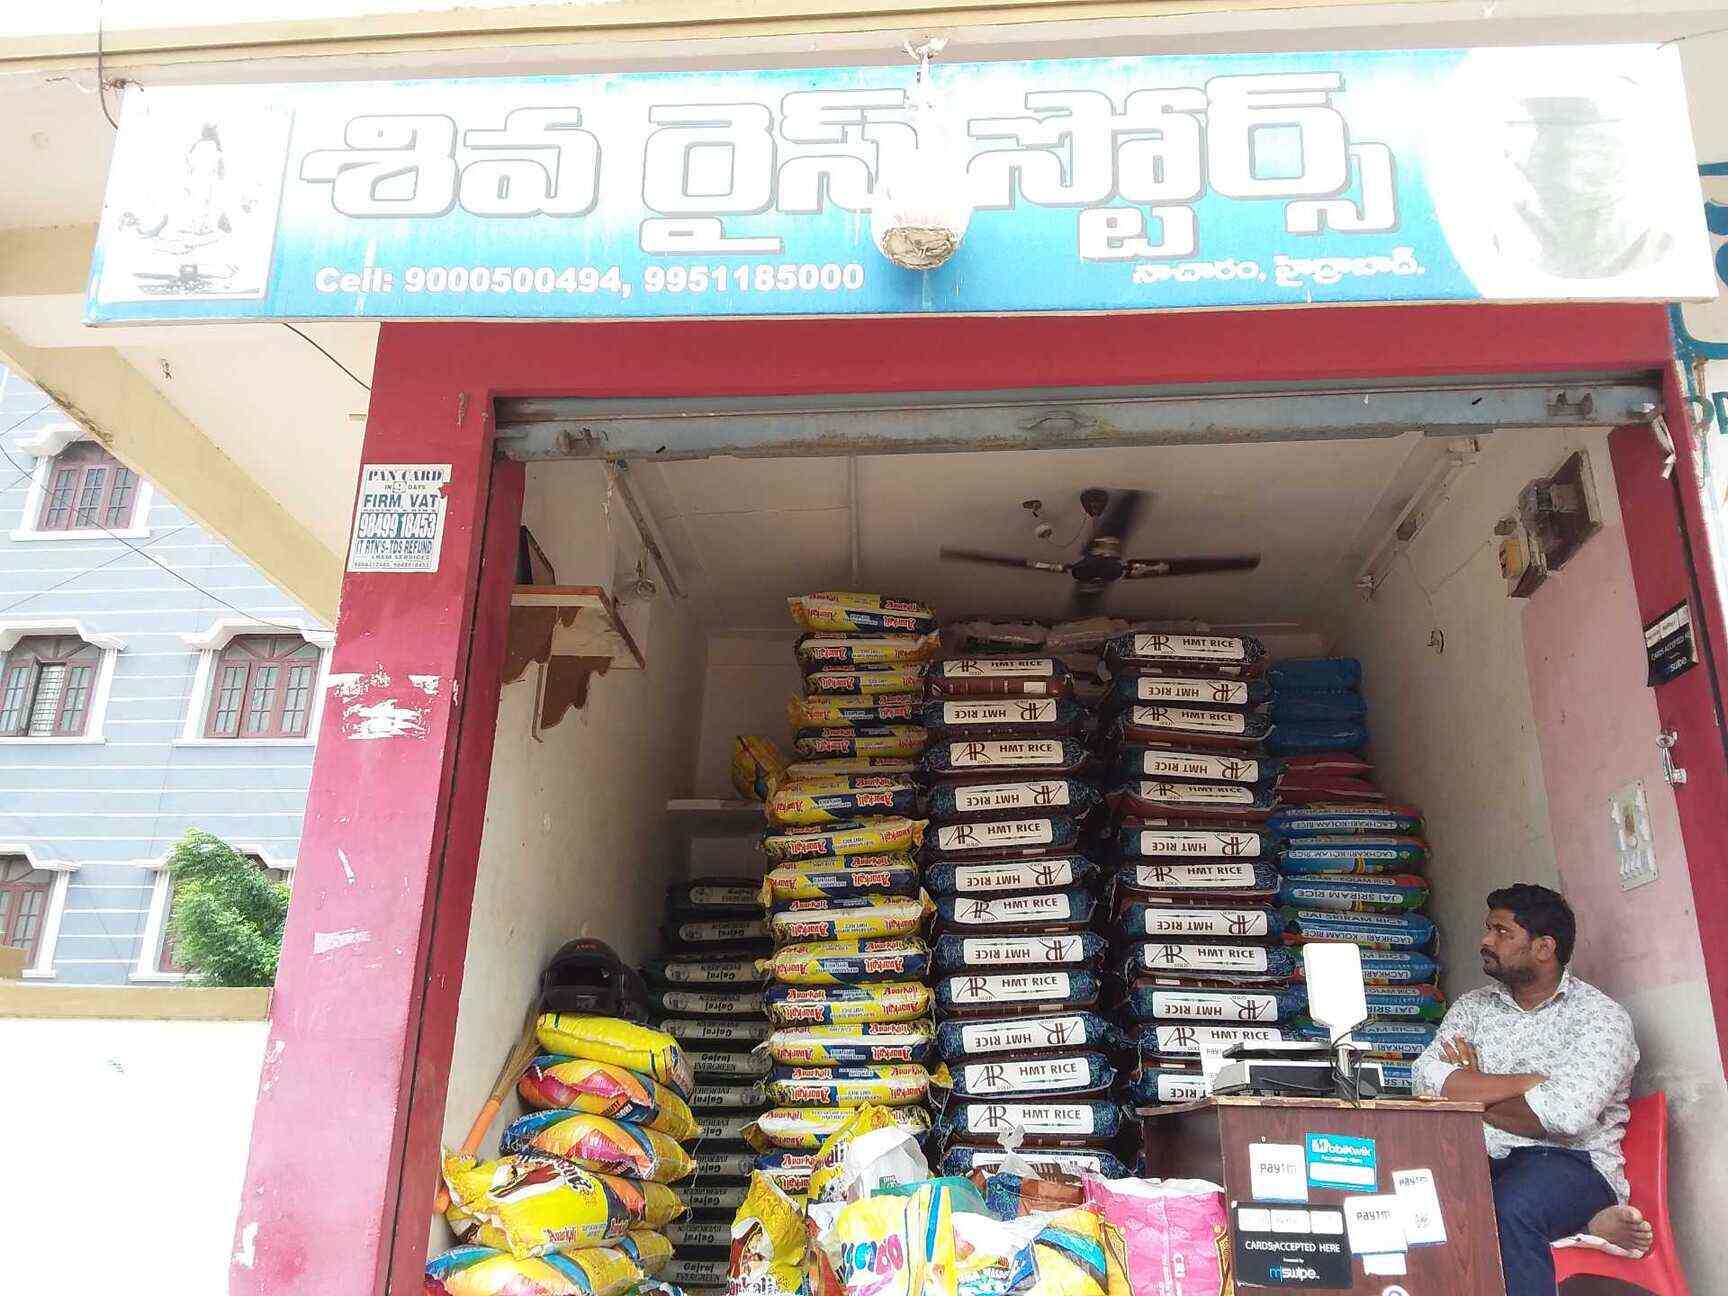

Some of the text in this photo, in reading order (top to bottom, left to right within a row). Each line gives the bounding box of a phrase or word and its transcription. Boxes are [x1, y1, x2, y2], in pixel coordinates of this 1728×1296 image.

[301, 105, 601, 217] శివ
[315, 263, 865, 298] Cell: 9000500494, 9951185000
[401, 470, 442, 481] CARD
[410, 494, 438, 507] VAT
[1182, 639, 1206, 647] HMT
[1210, 639, 1235, 648] RICE
[1175, 687, 1199, 697] HMT
[954, 710, 978, 718] RICE
[983, 709, 1007, 718] HMT
[1181, 711, 1206, 719] HMT
[1209, 712, 1235, 721] RICE
[1000, 744, 1024, 752] HMT
[1028, 743, 1053, 752] RICE
[1155, 761, 1179, 771] RICE
[1183, 763, 1208, 774] HMT
[966, 796, 991, 806] RICE
[994, 794, 1020, 804] HMT
[987, 825, 1012, 835] HMT
[1016, 823, 1041, 832] RICE
[1152, 841, 1176, 852] RICE
[1181, 842, 1207, 852] HMT
[1187, 867, 1213, 875] HMT
[1217, 867, 1243, 875] RICE
[967, 877, 992, 887] RICE
[995, 874, 1021, 884] HMT
[1003, 900, 1031, 910] HMT
[1033, 898, 1058, 907] RICE
[1157, 921, 1182, 931] RICE
[1187, 921, 1213, 931] HMT
[975, 950, 1000, 960] RICE
[1004, 949, 1031, 959] HMT
[1198, 948, 1225, 958] HMT
[1229, 949, 1256, 959] RICE
[1001, 978, 1029, 988] HMT
[1031, 976, 1058, 985] RICE
[1165, 1004, 1191, 1015] RICE
[1196, 1005, 1222, 1015] HMT
[1004, 1033, 1032, 1044] HMT
[1211, 1030, 1238, 1040] HMT
[1243, 1031, 1269, 1040] RICE
[975, 1036, 1001, 1048] RICE
[1019, 1065, 1047, 1077] HMT
[1050, 1063, 1078, 1073] RICE
[1170, 1088, 1197, 1098] RICE
[1022, 1109, 1050, 1119] HMT
[1054, 1109, 1082, 1119] RICE
[1245, 1241, 1341, 1253] CARDS ACCEPTED HERE
